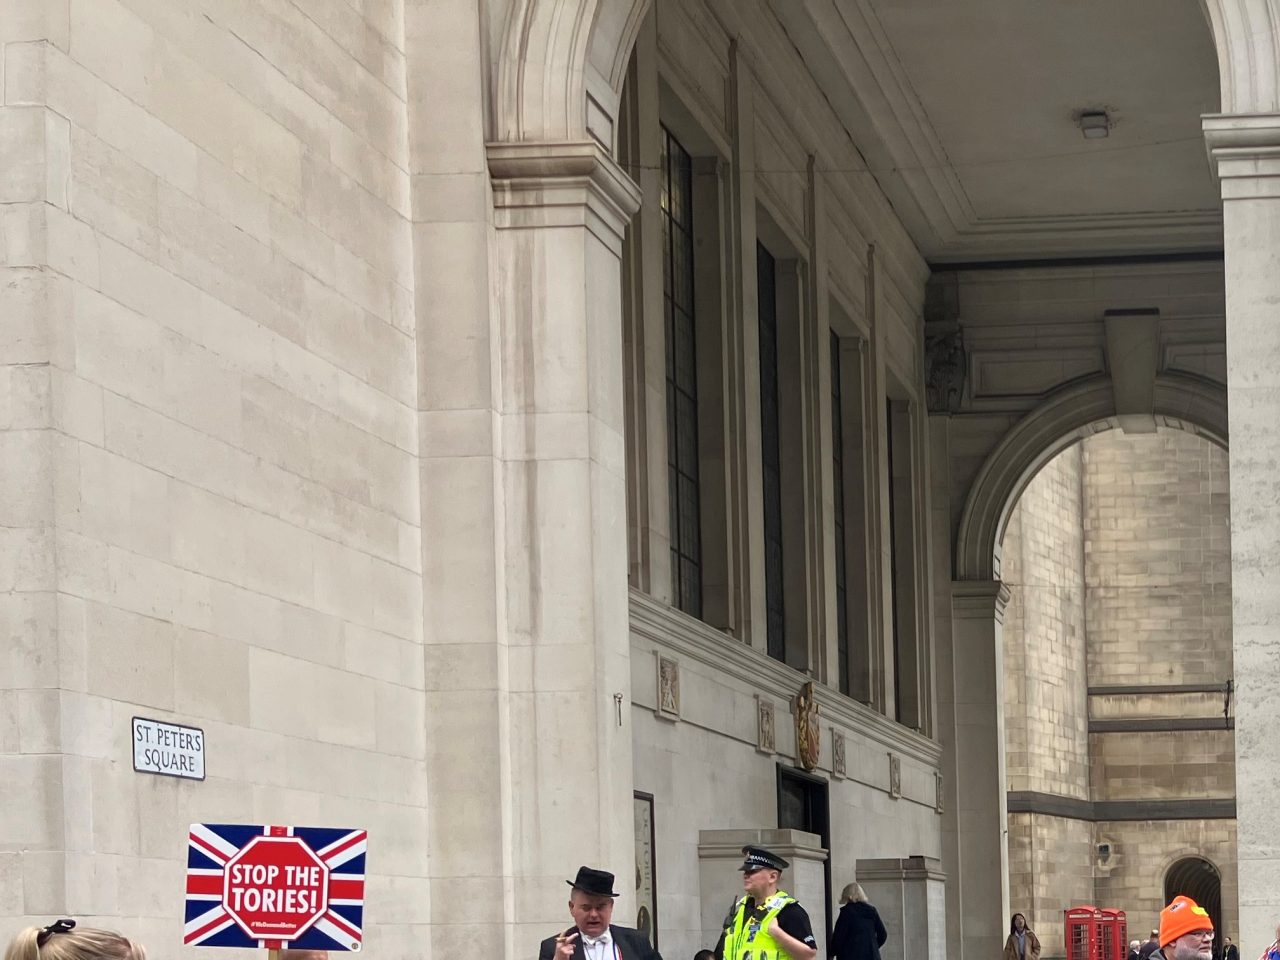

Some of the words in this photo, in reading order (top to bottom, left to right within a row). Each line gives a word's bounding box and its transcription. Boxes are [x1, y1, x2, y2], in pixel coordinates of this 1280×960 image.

[136, 724, 154, 744] ST.
[157, 728, 201, 752] PETER'S
[144, 748, 195, 772] SQUARE
[231, 863, 279, 885] STOP
[284, 865, 320, 887] THE
[231, 887, 317, 914] TORIES!
